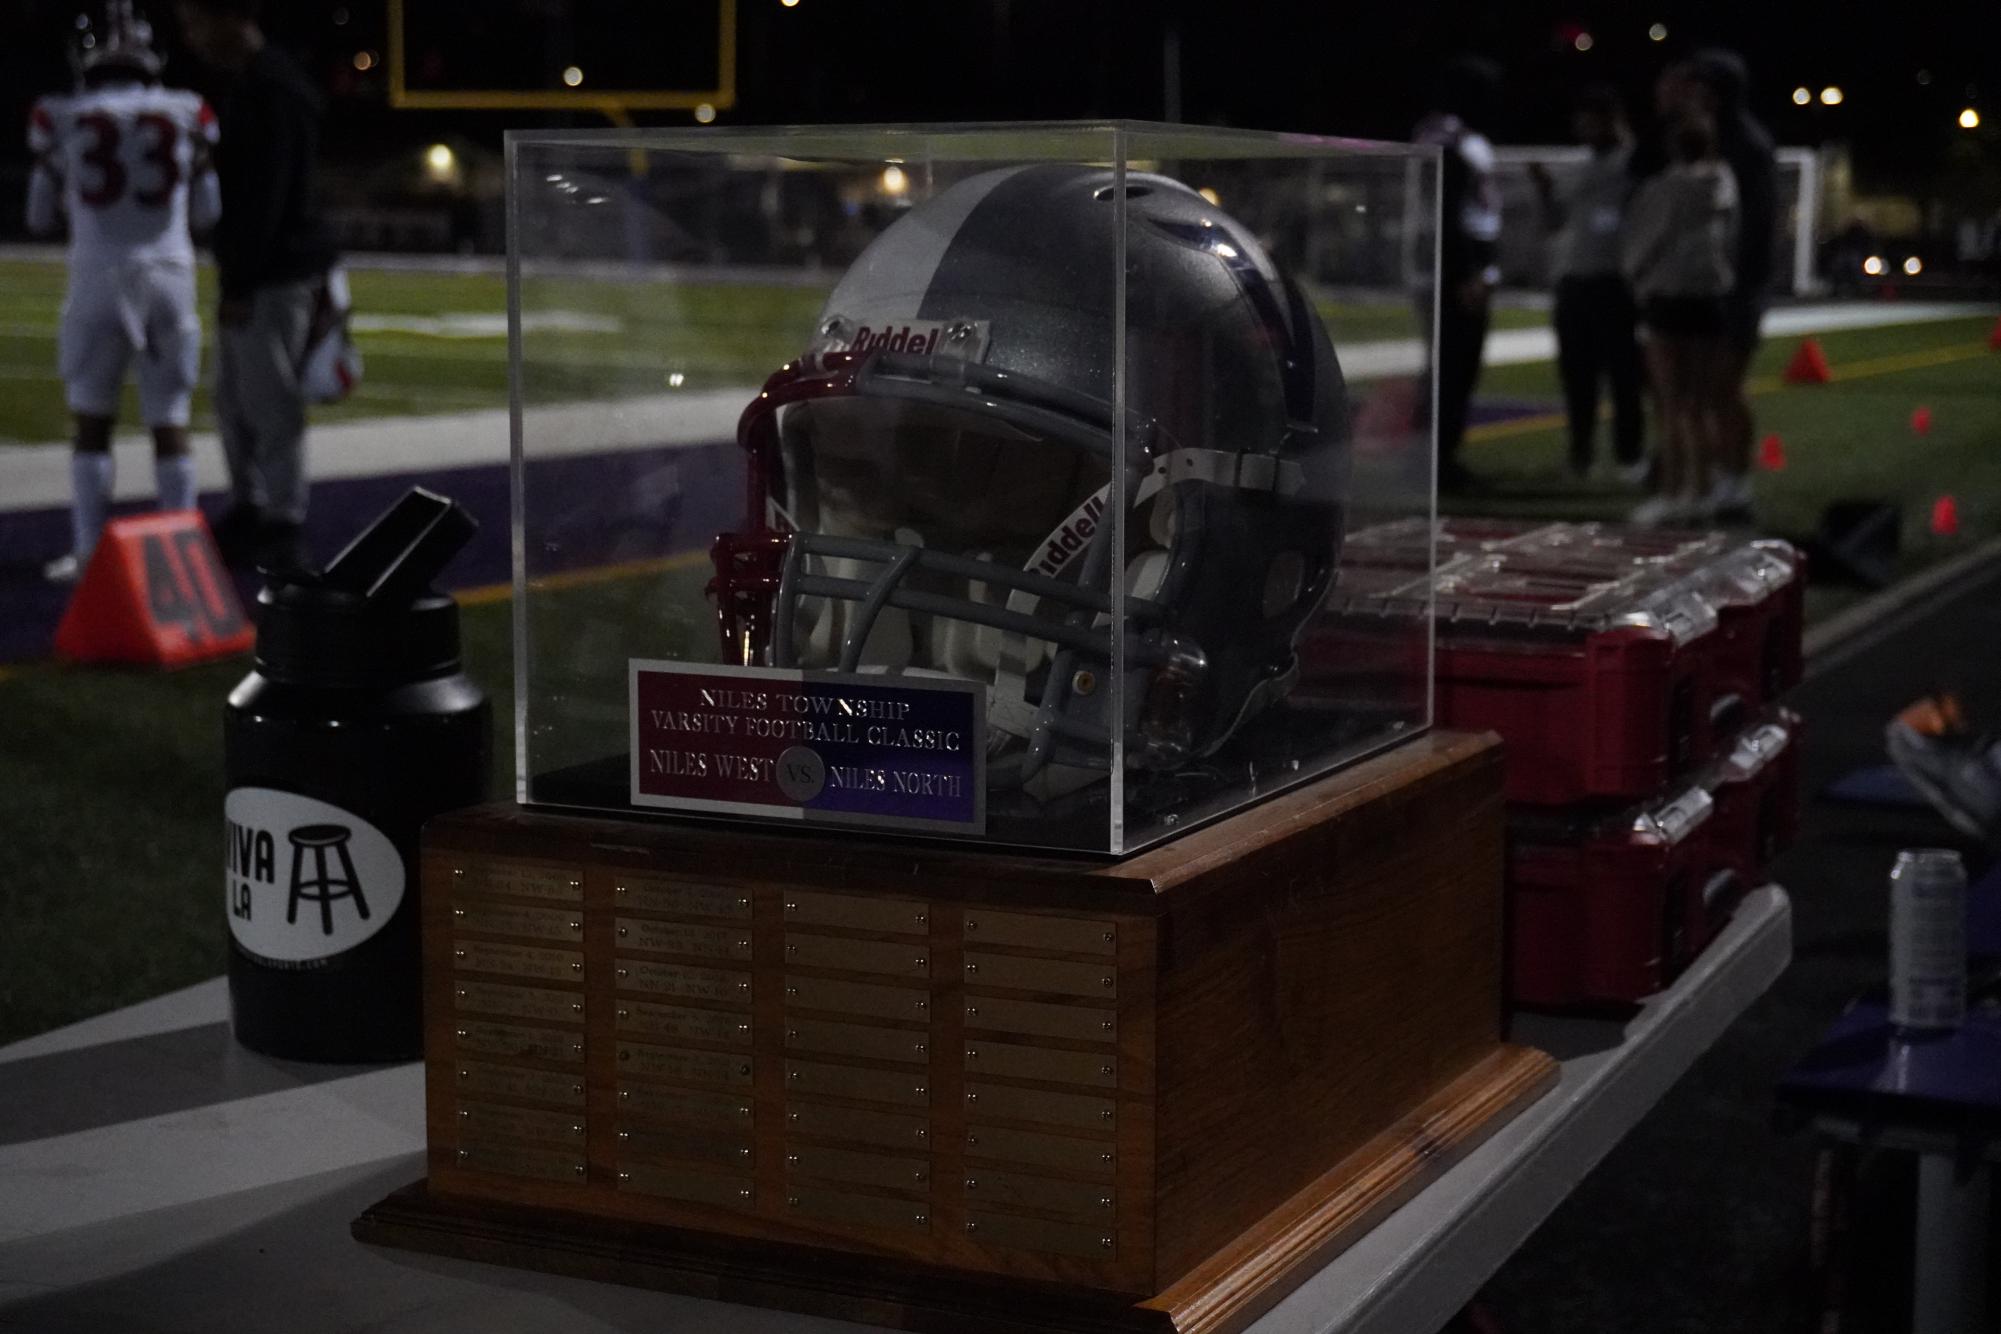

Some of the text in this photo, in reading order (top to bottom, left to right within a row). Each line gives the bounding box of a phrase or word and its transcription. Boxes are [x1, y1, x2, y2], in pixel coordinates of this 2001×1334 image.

[76, 110, 178, 207] 33
[1025, 497, 1104, 575] iddell
[143, 528, 247, 641] 40
[700, 688, 910, 721] NILES TOWNSHIP
[651, 709, 961, 752] VARSITY FOOTBALL CLASSIC
[649, 749, 961, 798] NILES WEST VS. NILES NORTH
[232, 876, 252, 921] LA
